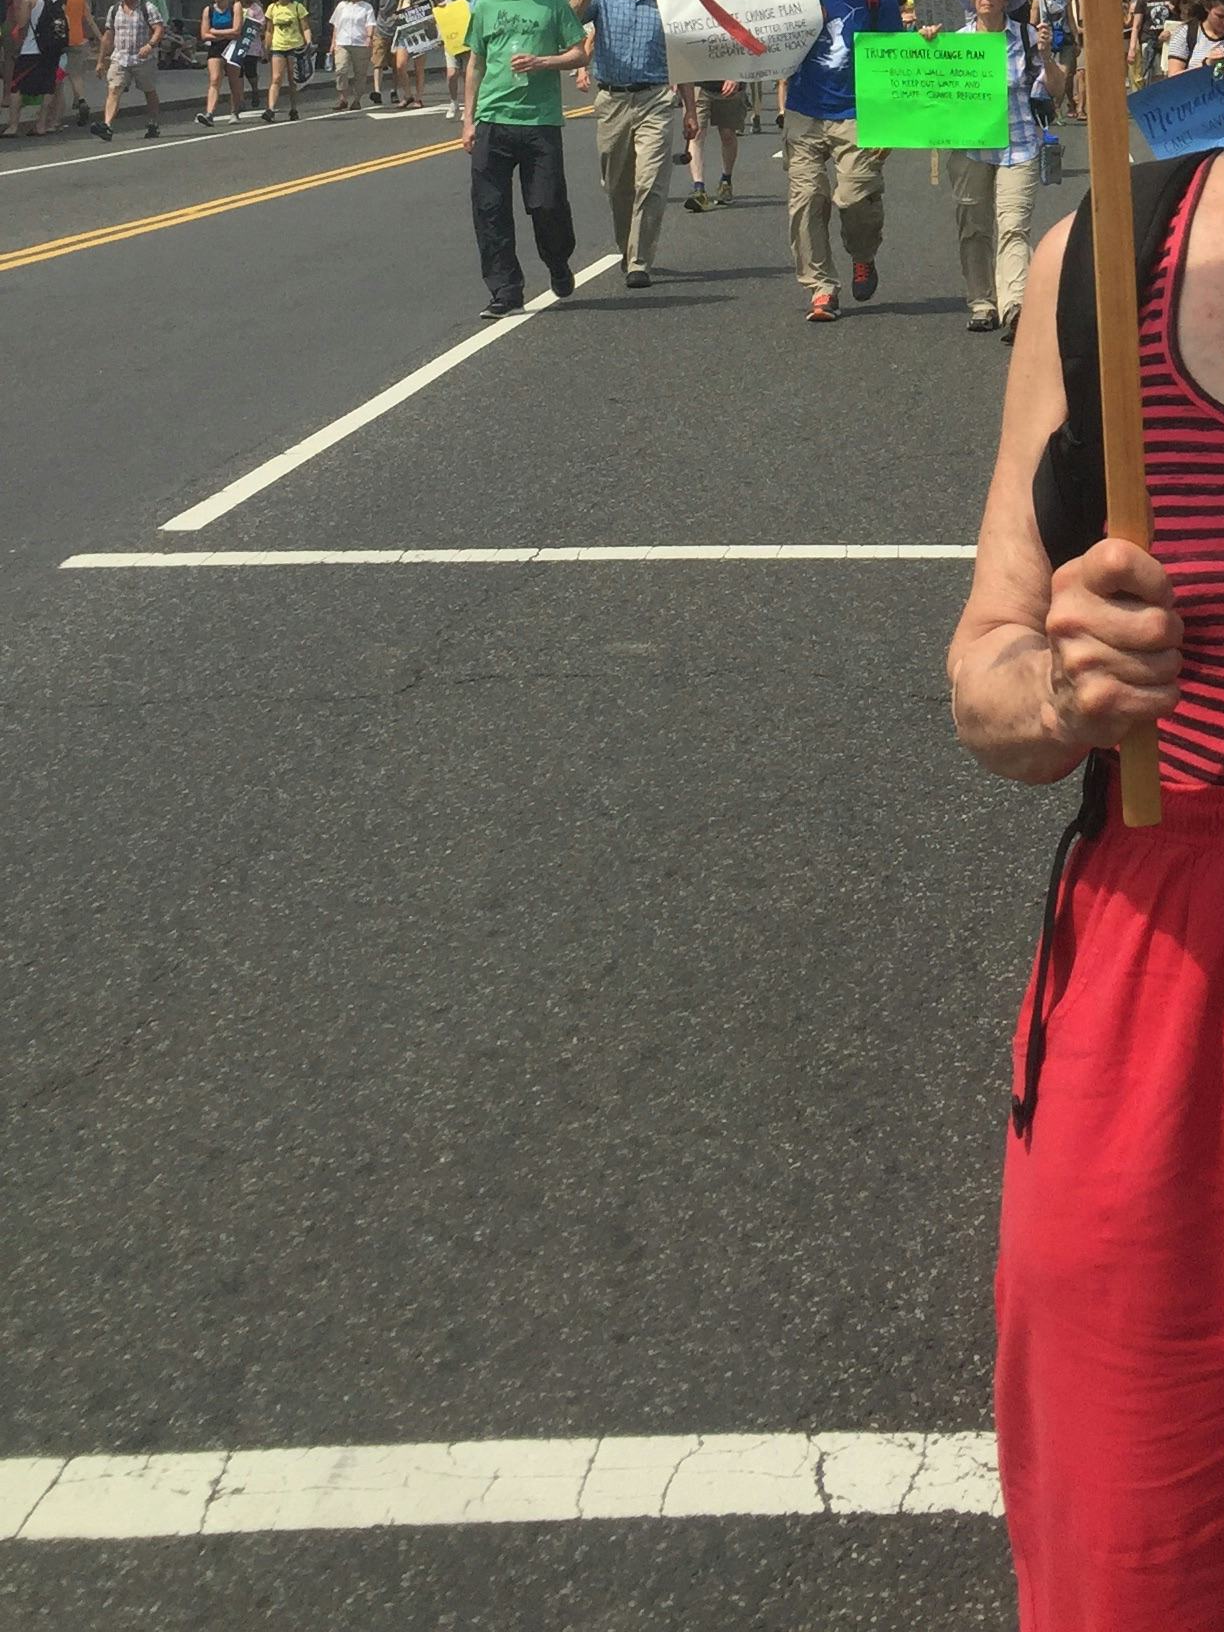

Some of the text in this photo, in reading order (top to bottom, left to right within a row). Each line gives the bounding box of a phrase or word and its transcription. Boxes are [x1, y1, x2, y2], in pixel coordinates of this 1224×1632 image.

[900, 48, 931, 60] CLIMATE
[933, 49, 962, 60] CHANGE
[966, 49, 985, 60] PLAN
